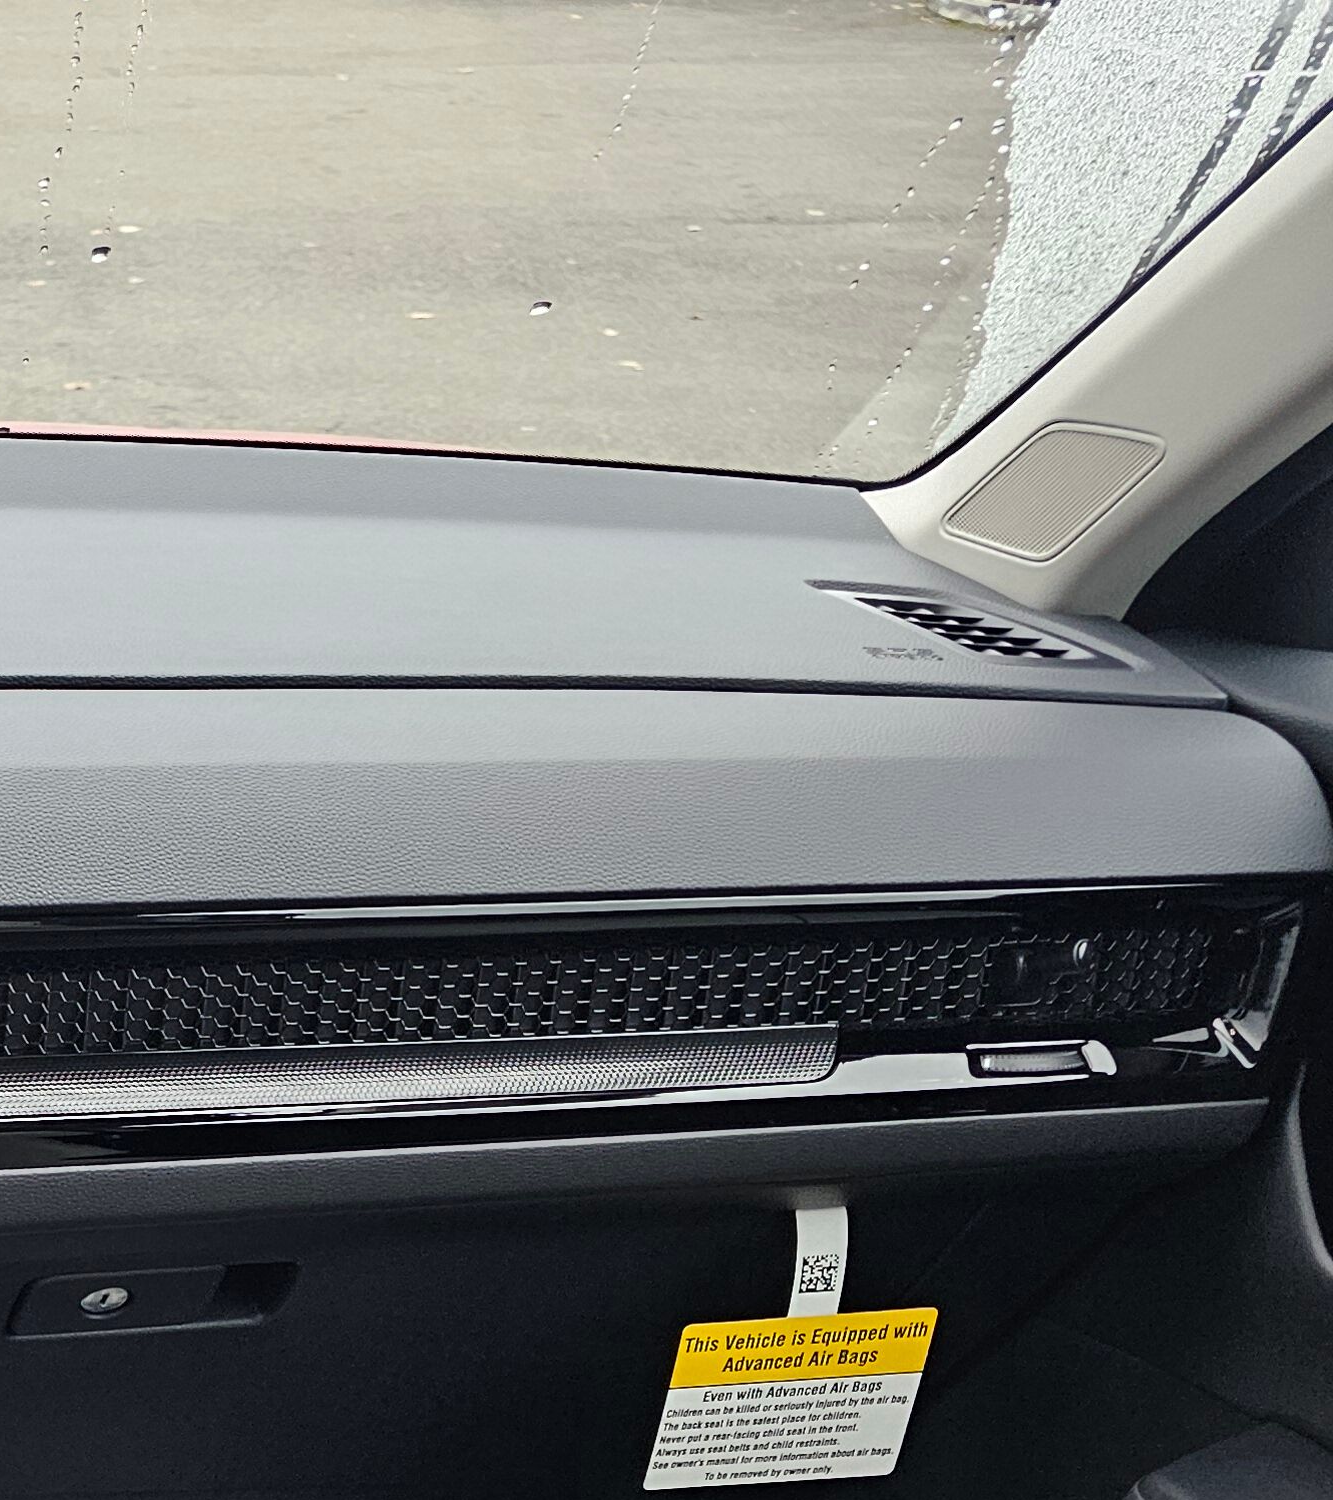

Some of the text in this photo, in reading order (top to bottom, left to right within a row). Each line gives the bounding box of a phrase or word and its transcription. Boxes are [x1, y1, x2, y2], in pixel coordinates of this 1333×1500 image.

[685, 1321, 928, 1353] This Vehicle is Equipped with
[722, 1348, 878, 1372] Advanced Air Bags
[703, 1381, 883, 1403] Even with Advanced Air Bags
[666, 1409, 703, 1418] Children
[705, 1408, 720, 1416] can
[723, 1406, 734, 1414] be
[736, 1404, 760, 1413] killed
[774, 1401, 814, 1411] seriously
[815, 1398, 846, 1409] injured
[848, 1397, 859, 1407] by
[861, 1396, 874, 1405] the
[876, 1396, 889, 1405] air
[891, 1395, 909, 1404] bag.
[663, 1411, 861, 1431] The back seat is the safest place for children.
[659, 1436, 685, 1444] Never
[687, 1434, 701, 1444] put
[712, 1431, 760, 1441] rear-facing
[762, 1428, 785, 1438] child
[786, 1427, 806, 1436] seat
[808, 1426, 817, 1435] in
[818, 1425, 833, 1433] the
[835, 1423, 859, 1433] front.
[652, 1447, 893, 1470] See owner's manual for more information about air bags.
[655, 1448, 687, 1457] Always
[706, 1445, 726, 1454] seat
[728, 1443, 750, 1452] belts
[753, 1442, 770, 1451] and
[771, 1440, 793, 1449] child
[795, 1438, 840, 1448] restraints.
[704, 1466, 833, 1481] To be removed by owner only.
